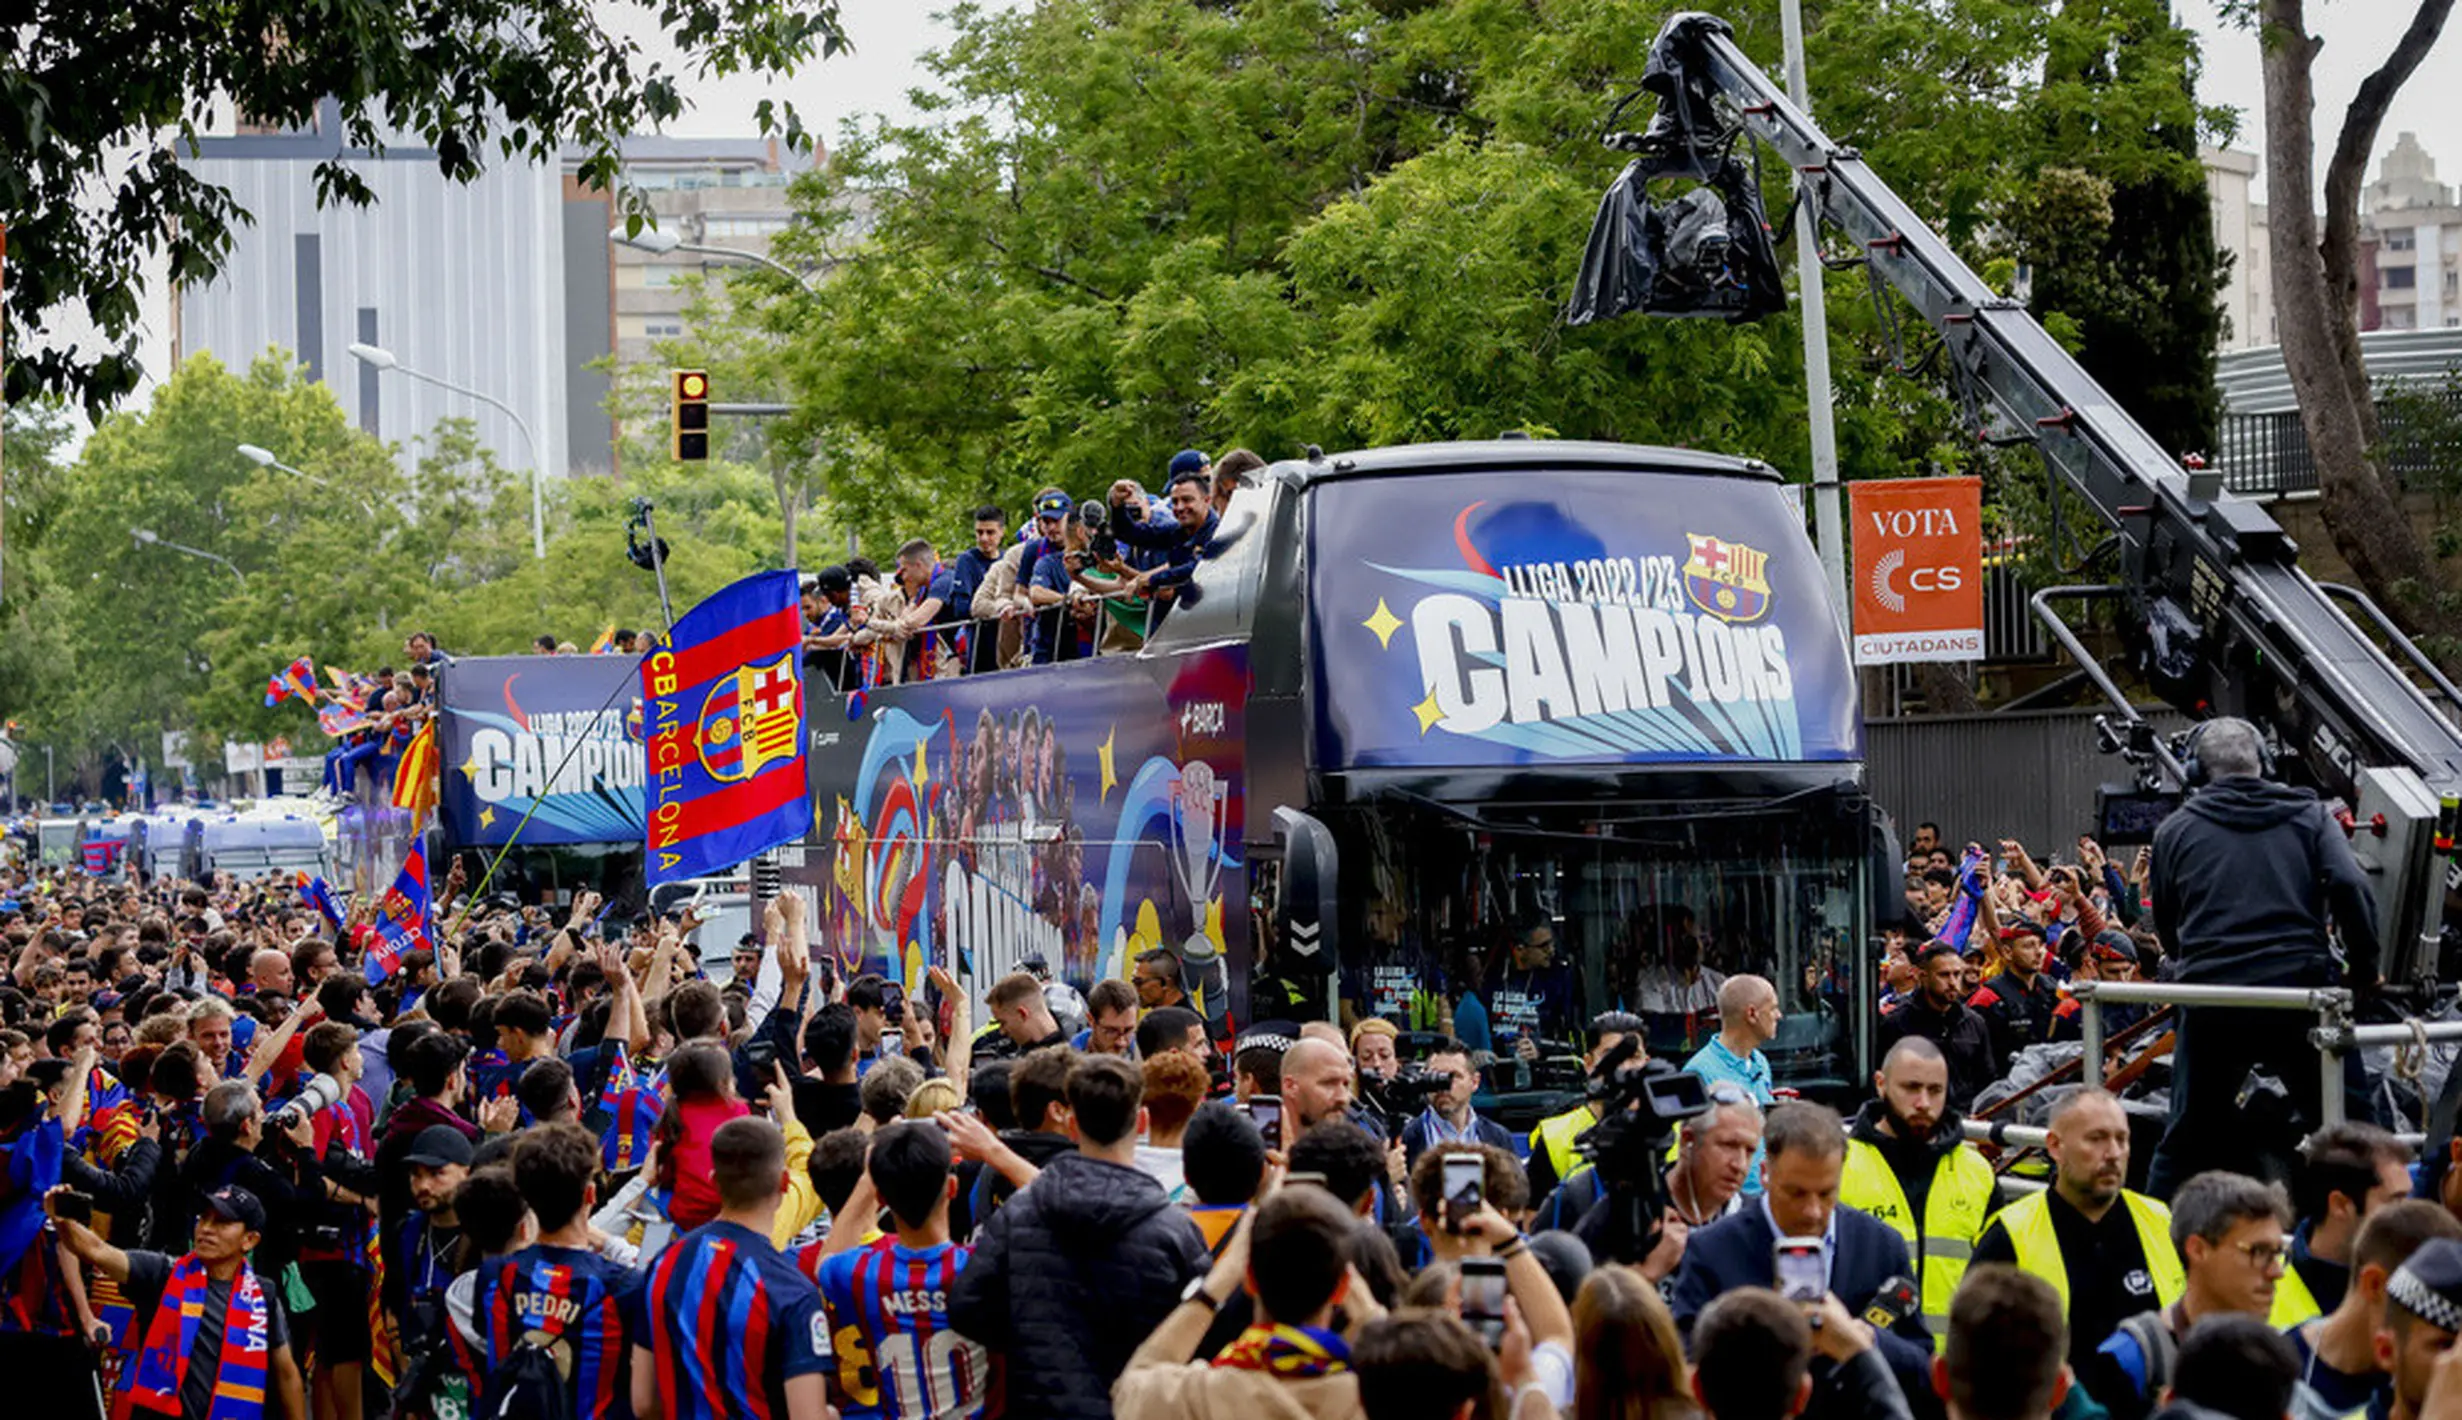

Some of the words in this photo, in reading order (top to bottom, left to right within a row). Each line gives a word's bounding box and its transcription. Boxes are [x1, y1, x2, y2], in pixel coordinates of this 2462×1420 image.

[1871, 508, 1959, 537] VOTA
[1502, 562, 1574, 600] LLIGA
[1574, 556, 1686, 613] 2022/23
[1910, 566, 1962, 591] CS
[1411, 593, 1793, 733] CAMPIONS
[1861, 637, 1979, 656] CIUTADANS
[471, 728, 645, 802] CAMPION
[514, 1291, 581, 1325] PEDRI
[882, 1290, 948, 1317] MESS
[878, 1329, 989, 1420] 10
